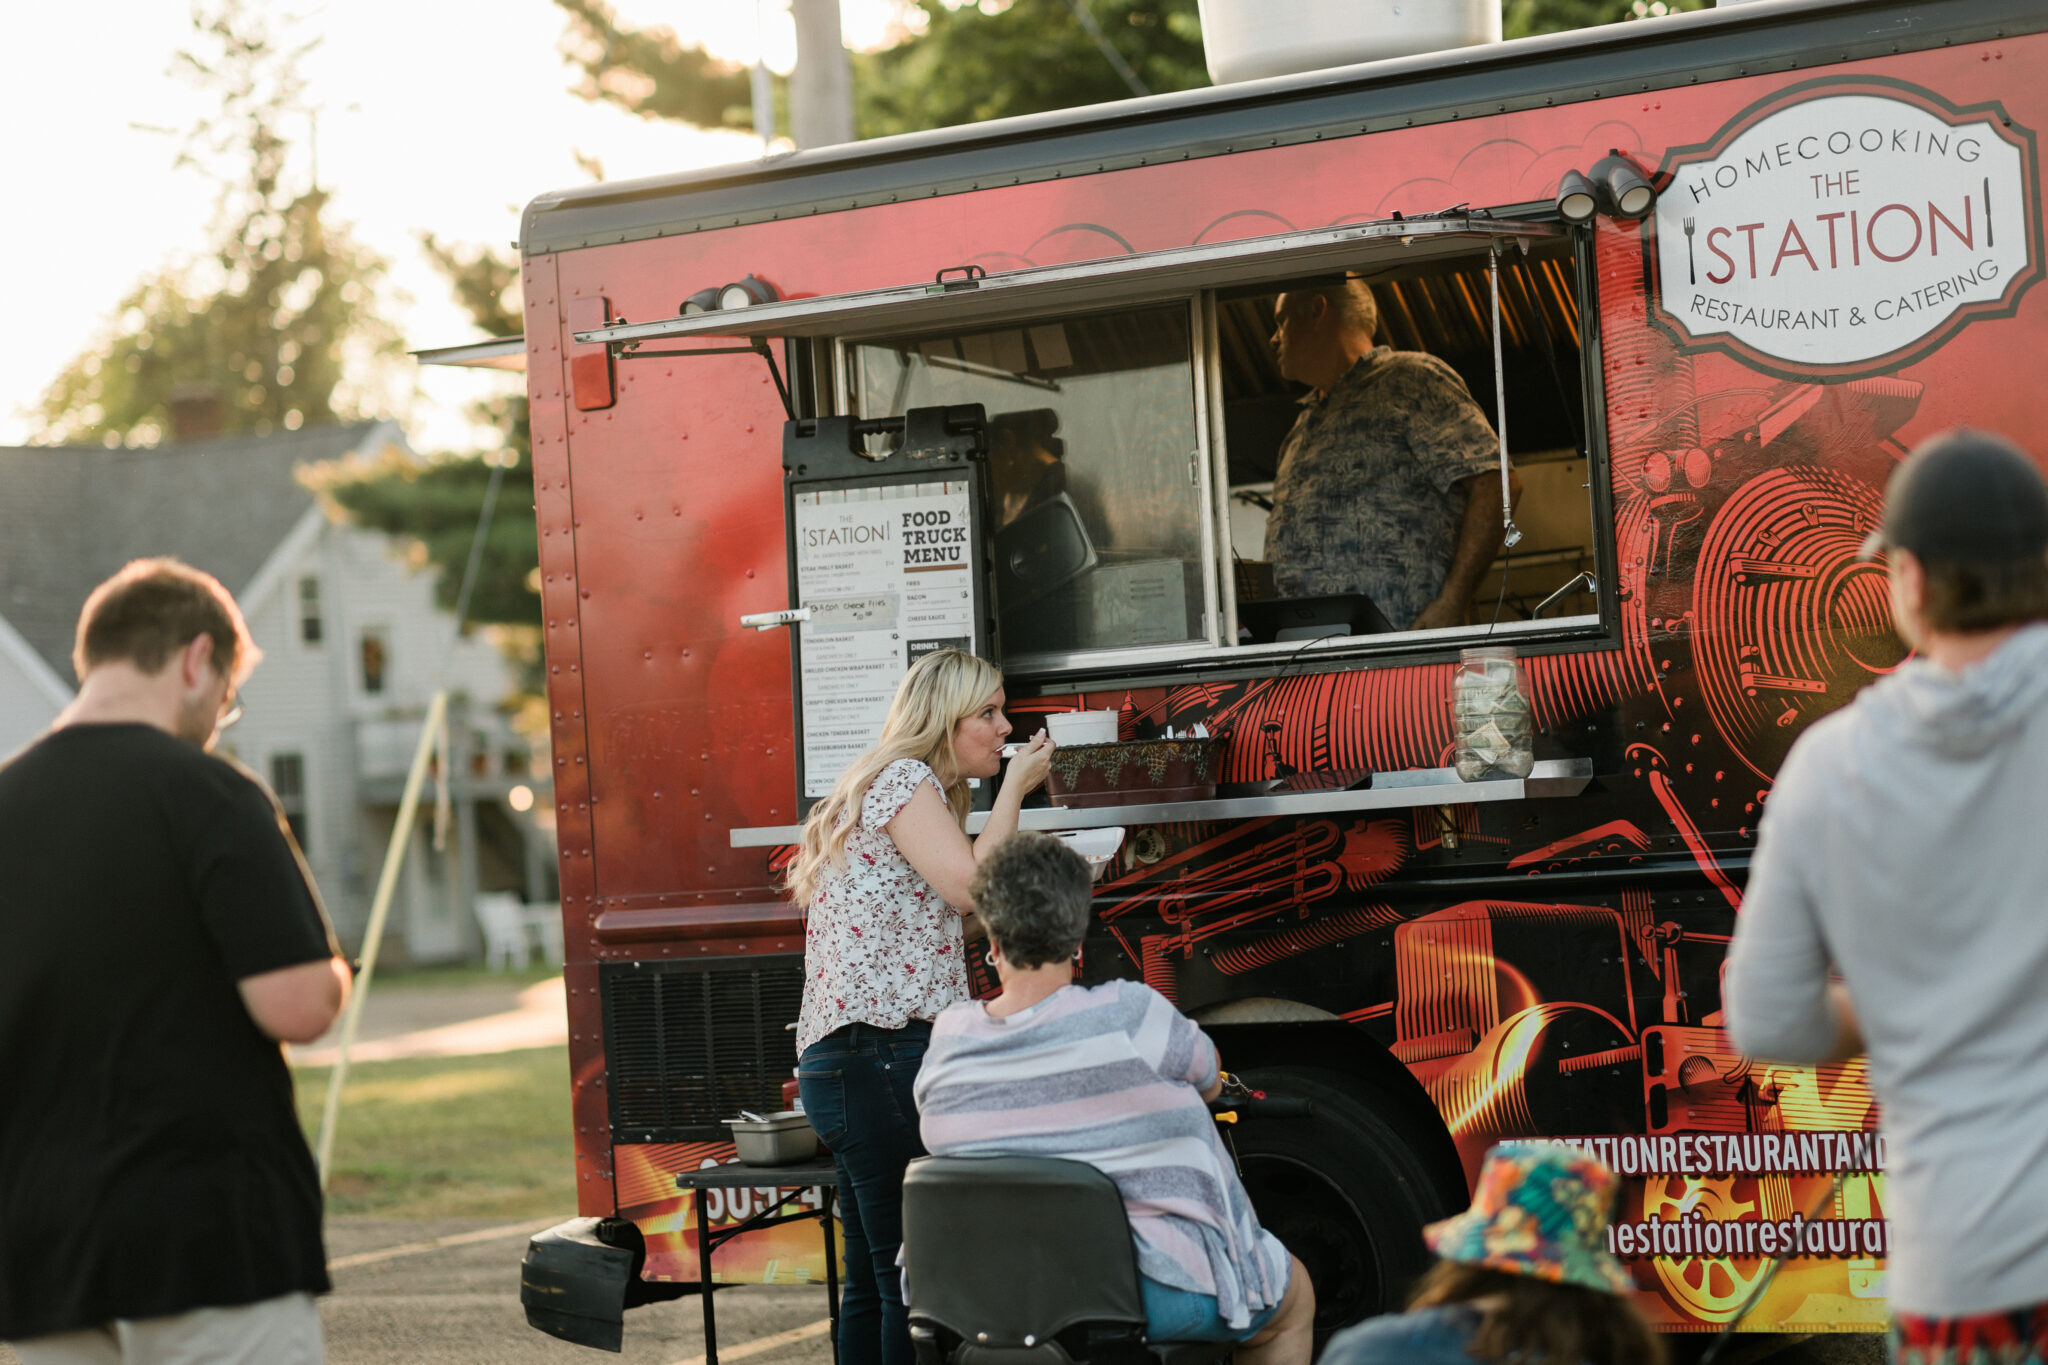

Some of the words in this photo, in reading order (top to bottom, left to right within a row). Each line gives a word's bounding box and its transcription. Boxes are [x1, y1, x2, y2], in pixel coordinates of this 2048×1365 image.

[1689, 128, 1981, 203] HOMECOOKING
[1810, 169, 1860, 199] THE
[1706, 195, 1974, 284] STATION
[1691, 294, 1840, 330] RESTAURANT
[1849, 307, 1867, 326] &
[1874, 259, 1999, 321] CATERING
[840, 515, 854, 523] THE
[902, 510, 951, 528] FOOD
[808, 524, 885, 547] STATION
[902, 527, 967, 546] TRUCK
[903, 546, 961, 564] MENU
[911, 642, 939, 651] DRINKS
[808, 744, 846, 752] CHEESEBURGER
[1499, 1134, 1887, 1173] TATIONRESTAURANTAND
